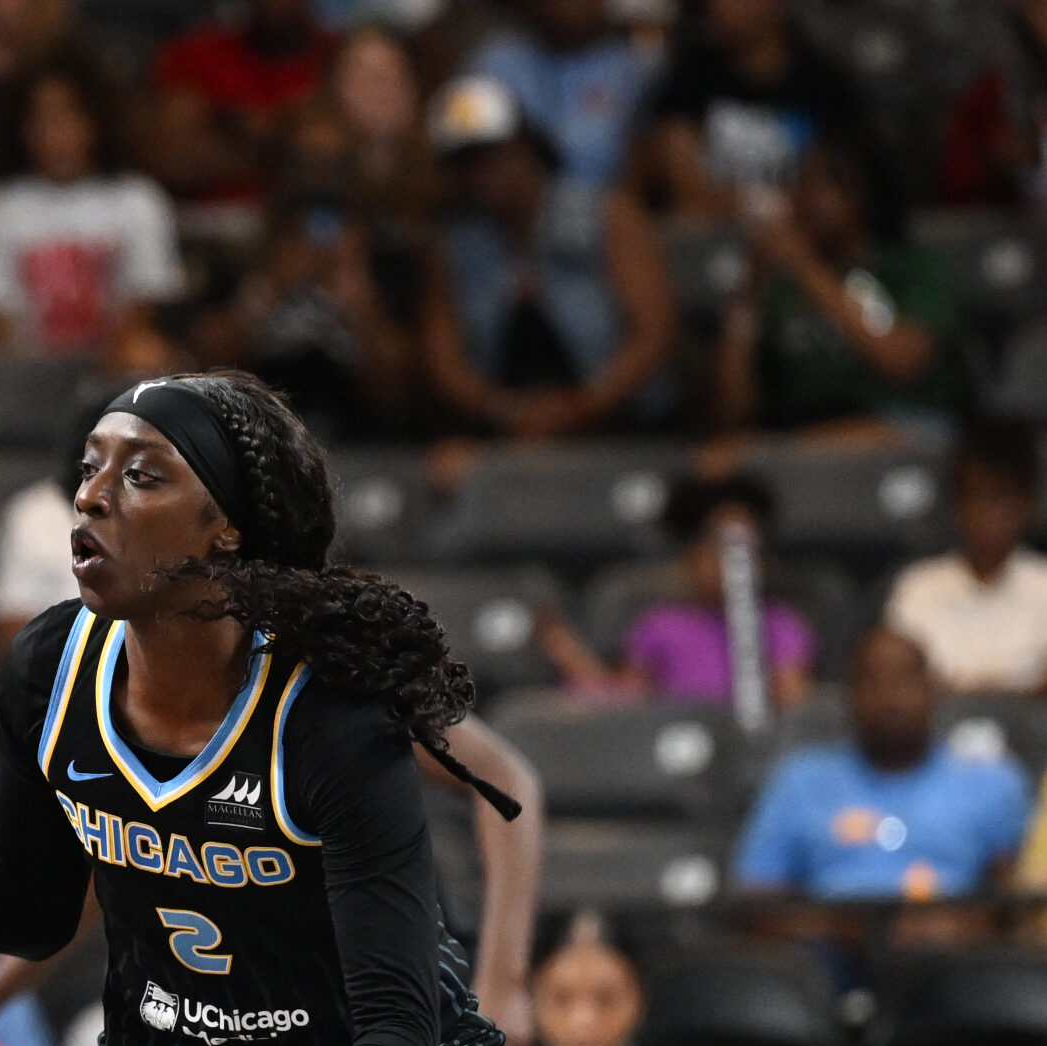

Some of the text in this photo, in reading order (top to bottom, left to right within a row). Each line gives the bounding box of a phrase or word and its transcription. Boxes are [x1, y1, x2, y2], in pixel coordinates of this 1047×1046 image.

[207, 804, 263, 819] MAGELLAN
[55, 789, 296, 888] CHICAGO
[155, 907, 233, 975] 2
[184, 998, 310, 1032] UChicago
